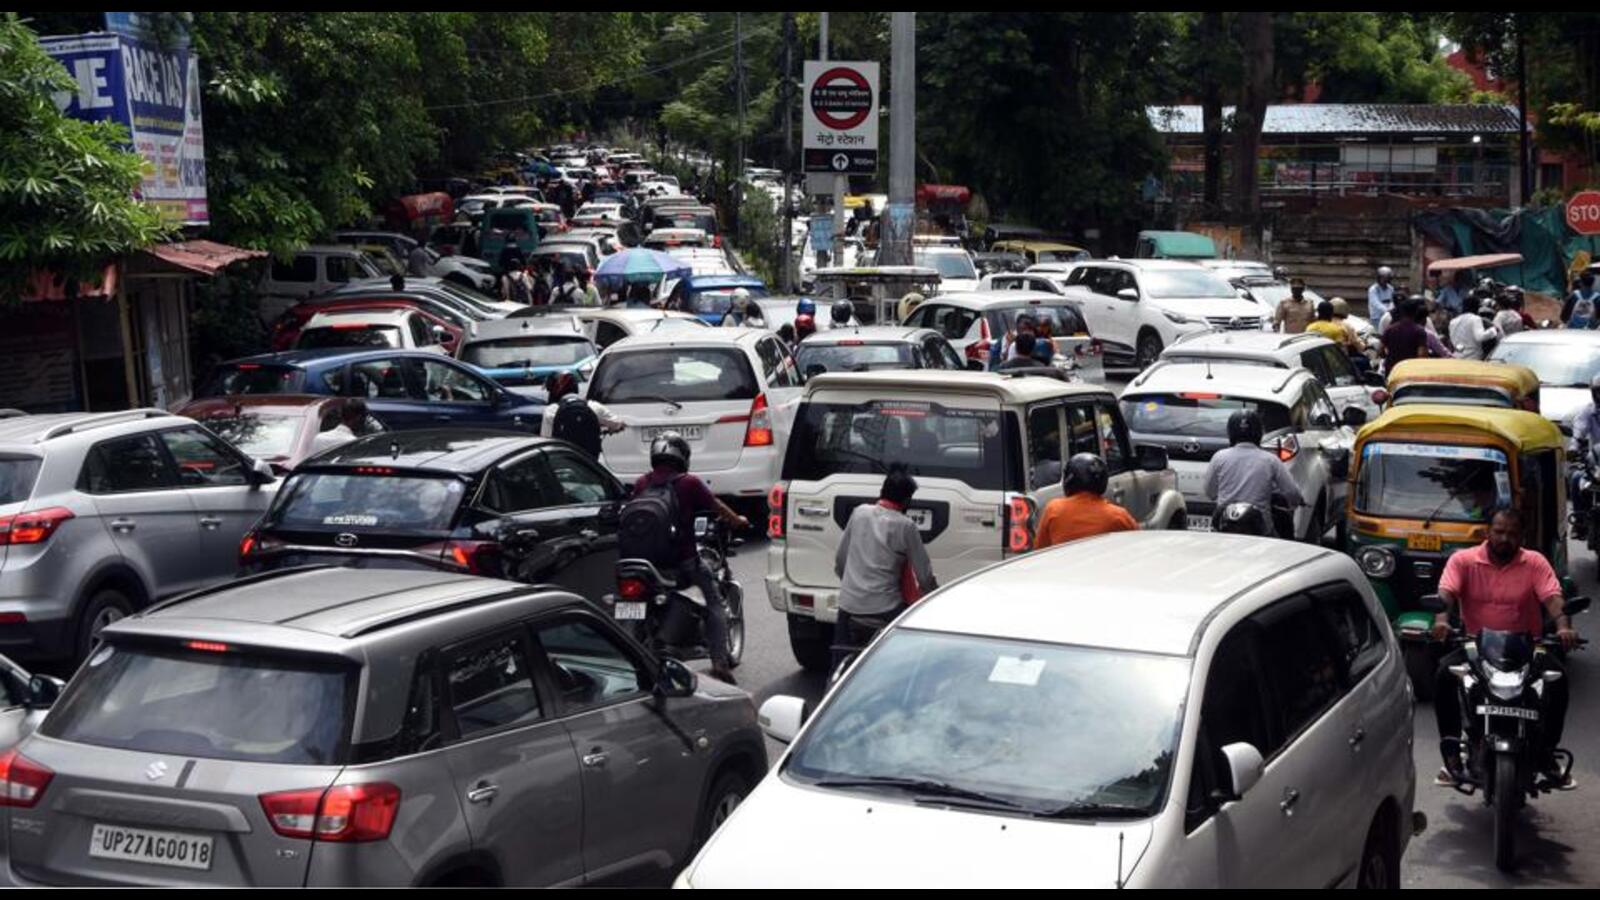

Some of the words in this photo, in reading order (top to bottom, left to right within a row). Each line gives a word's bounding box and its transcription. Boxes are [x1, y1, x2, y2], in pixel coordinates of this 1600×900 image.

[120, 44, 162, 104] RACE
[158, 53, 183, 108] IAS
[816, 131, 834, 145] मेट्रो
[837, 132, 866, 145] स्टेशन
[1570, 204, 1600, 222] STO
[102, 829, 210, 862] UP27AG0018
